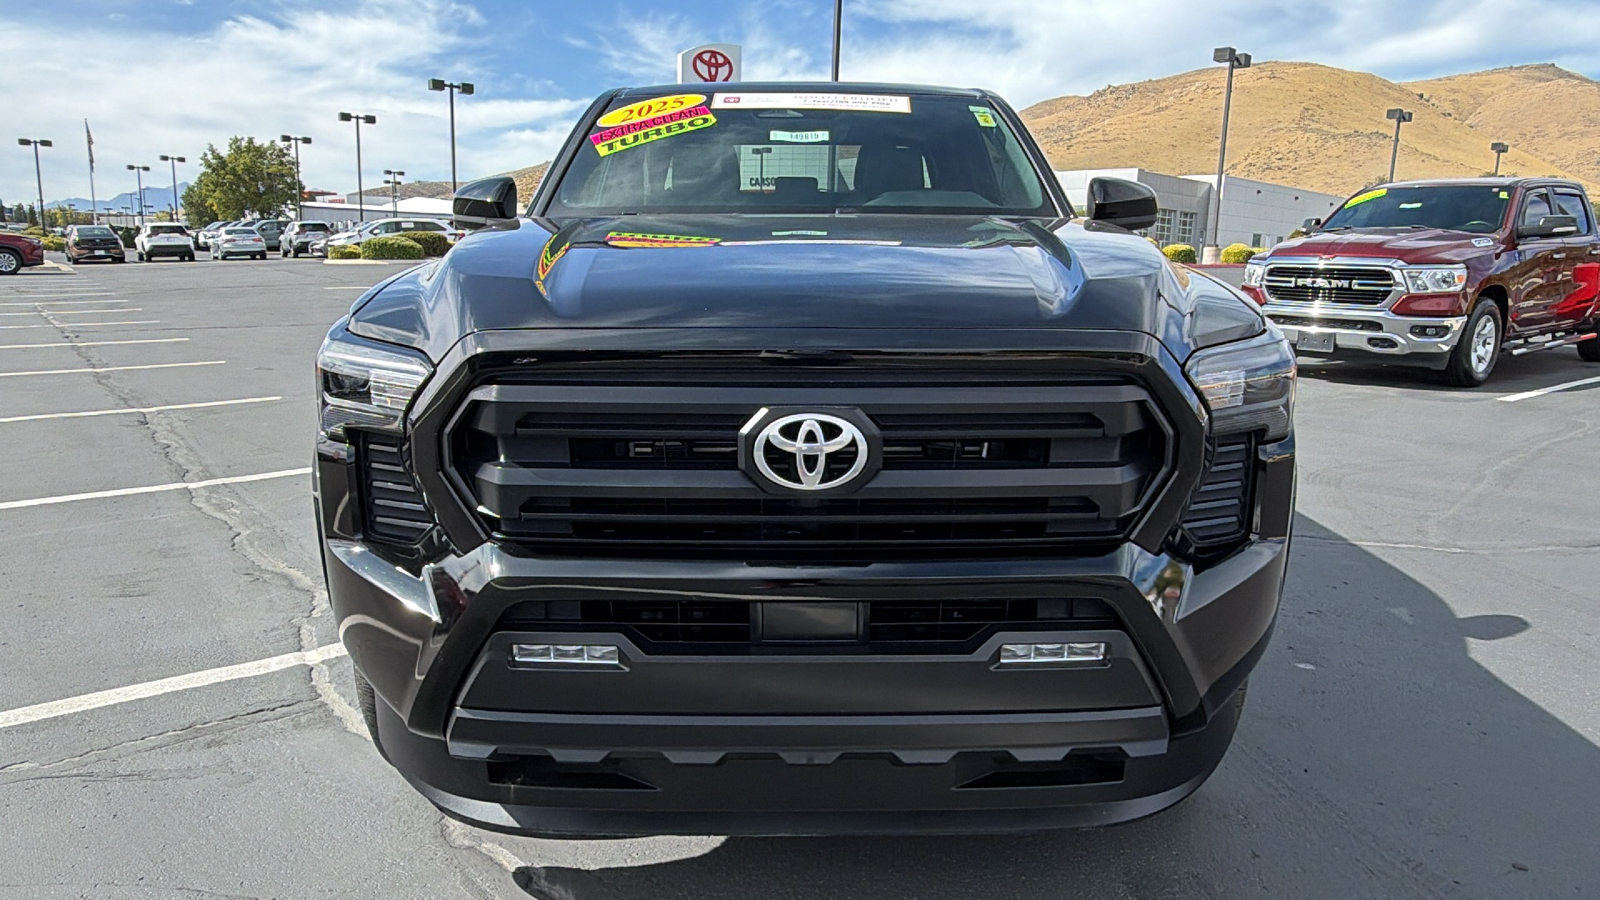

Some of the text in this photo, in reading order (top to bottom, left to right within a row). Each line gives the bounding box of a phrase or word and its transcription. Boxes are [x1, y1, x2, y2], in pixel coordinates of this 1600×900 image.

[620, 96, 686, 122] 2025
[600, 120, 649, 141] EXTRA
[601, 117, 709, 152] TURBO
[749, 177, 776, 187] CARSO
[1297, 278, 1350, 288] RAM
